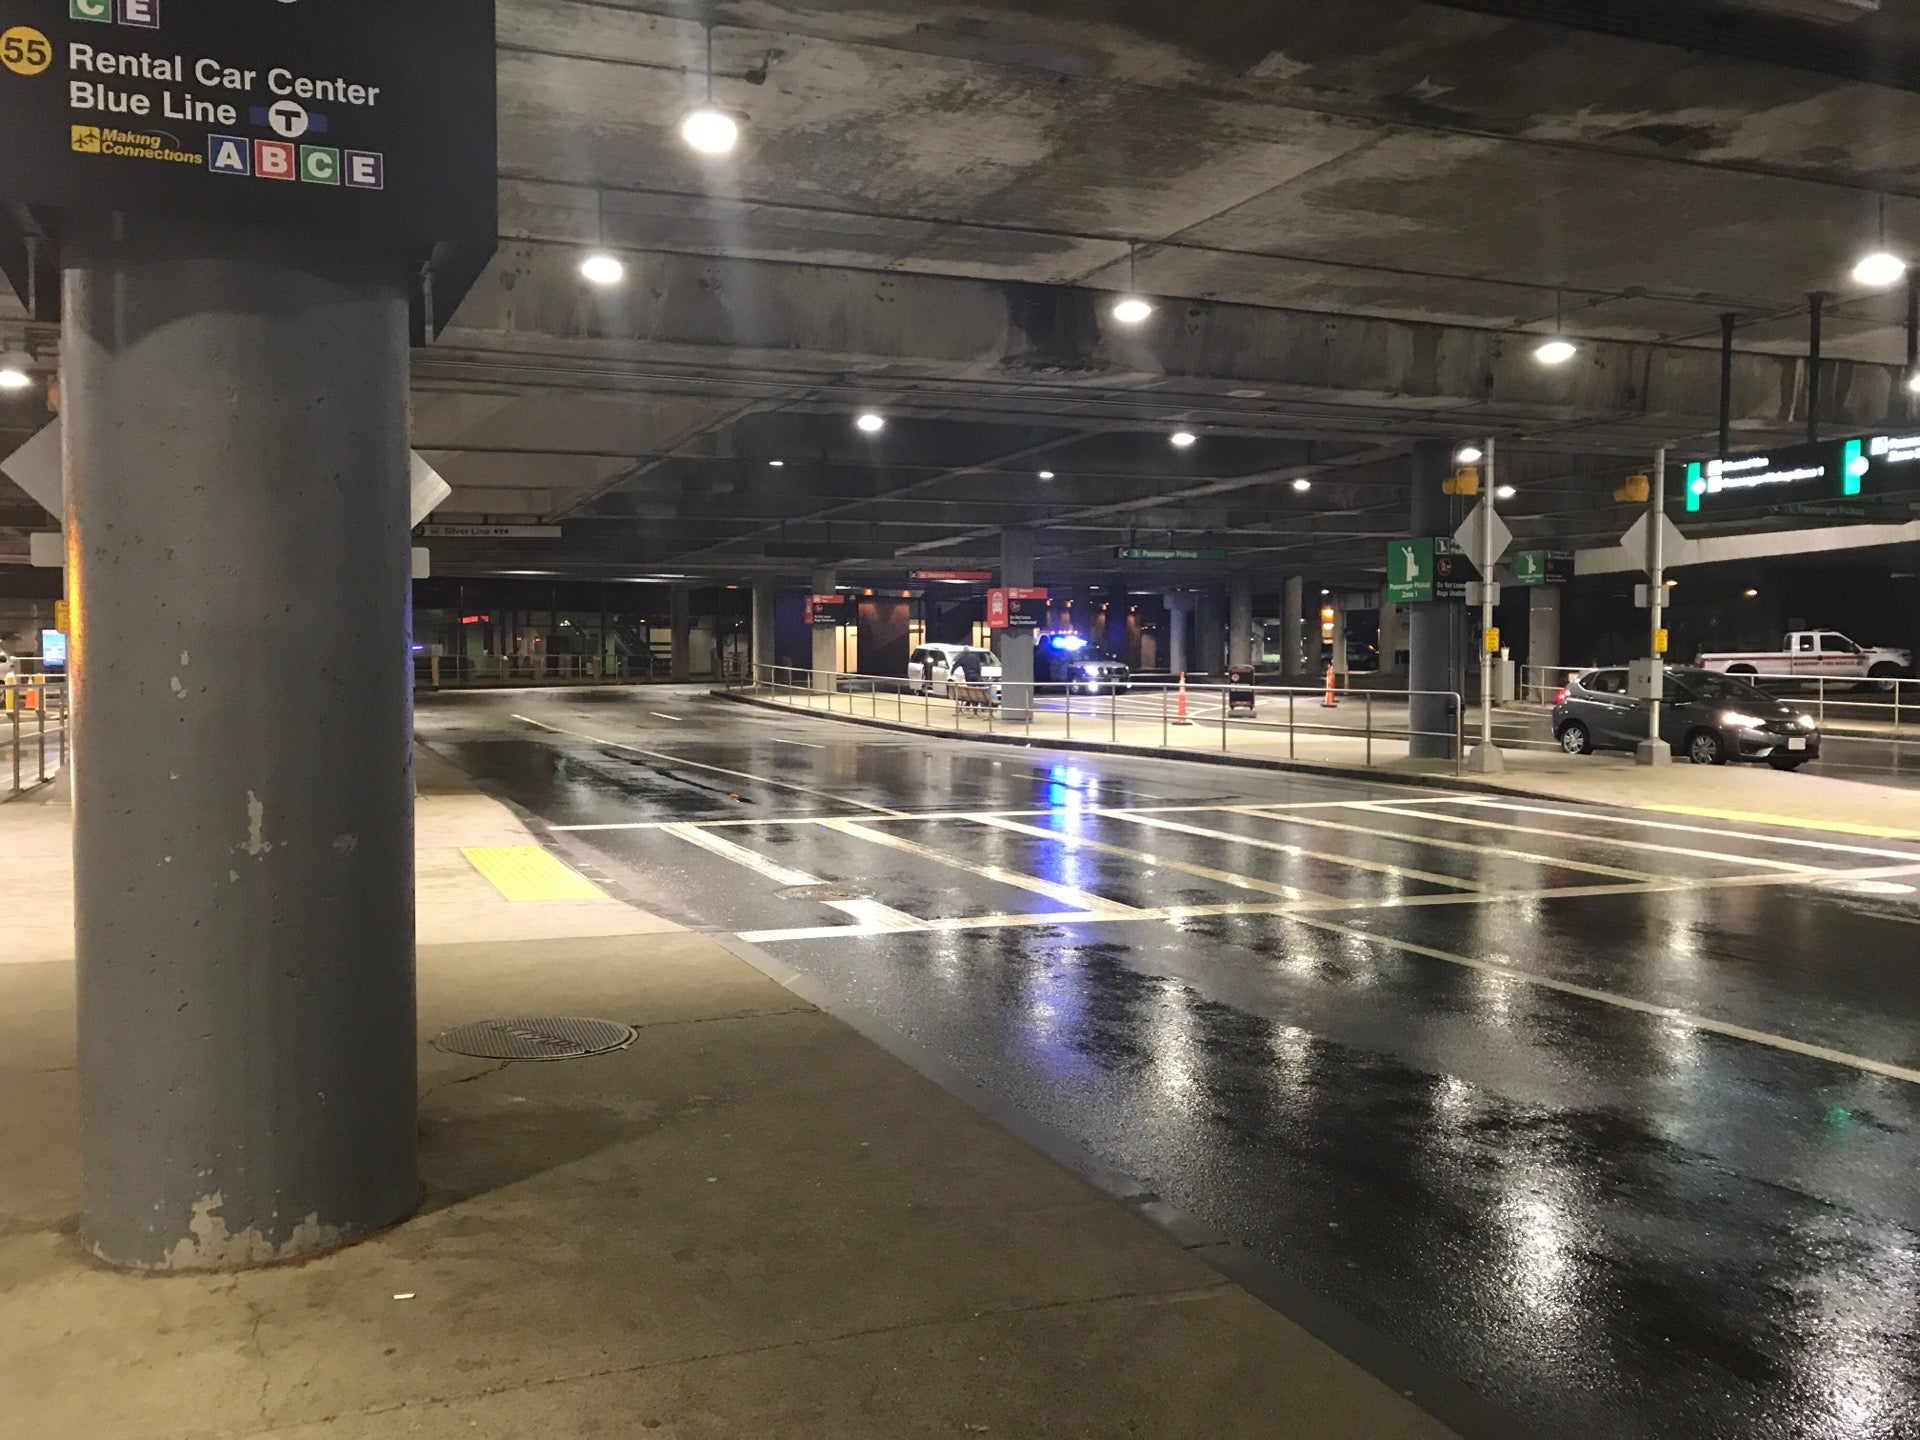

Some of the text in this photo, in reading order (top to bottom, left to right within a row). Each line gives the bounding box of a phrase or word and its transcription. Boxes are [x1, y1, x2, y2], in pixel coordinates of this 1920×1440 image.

[126, 0, 151, 21] E
[3, 37, 46, 66] 55
[69, 42, 380, 106] Rental Car Center
[70, 80, 302, 132] Blue Line T
[102, 128, 161, 148] Making
[102, 141, 203, 164] Connections
[214, 142, 376, 183] A B C E
